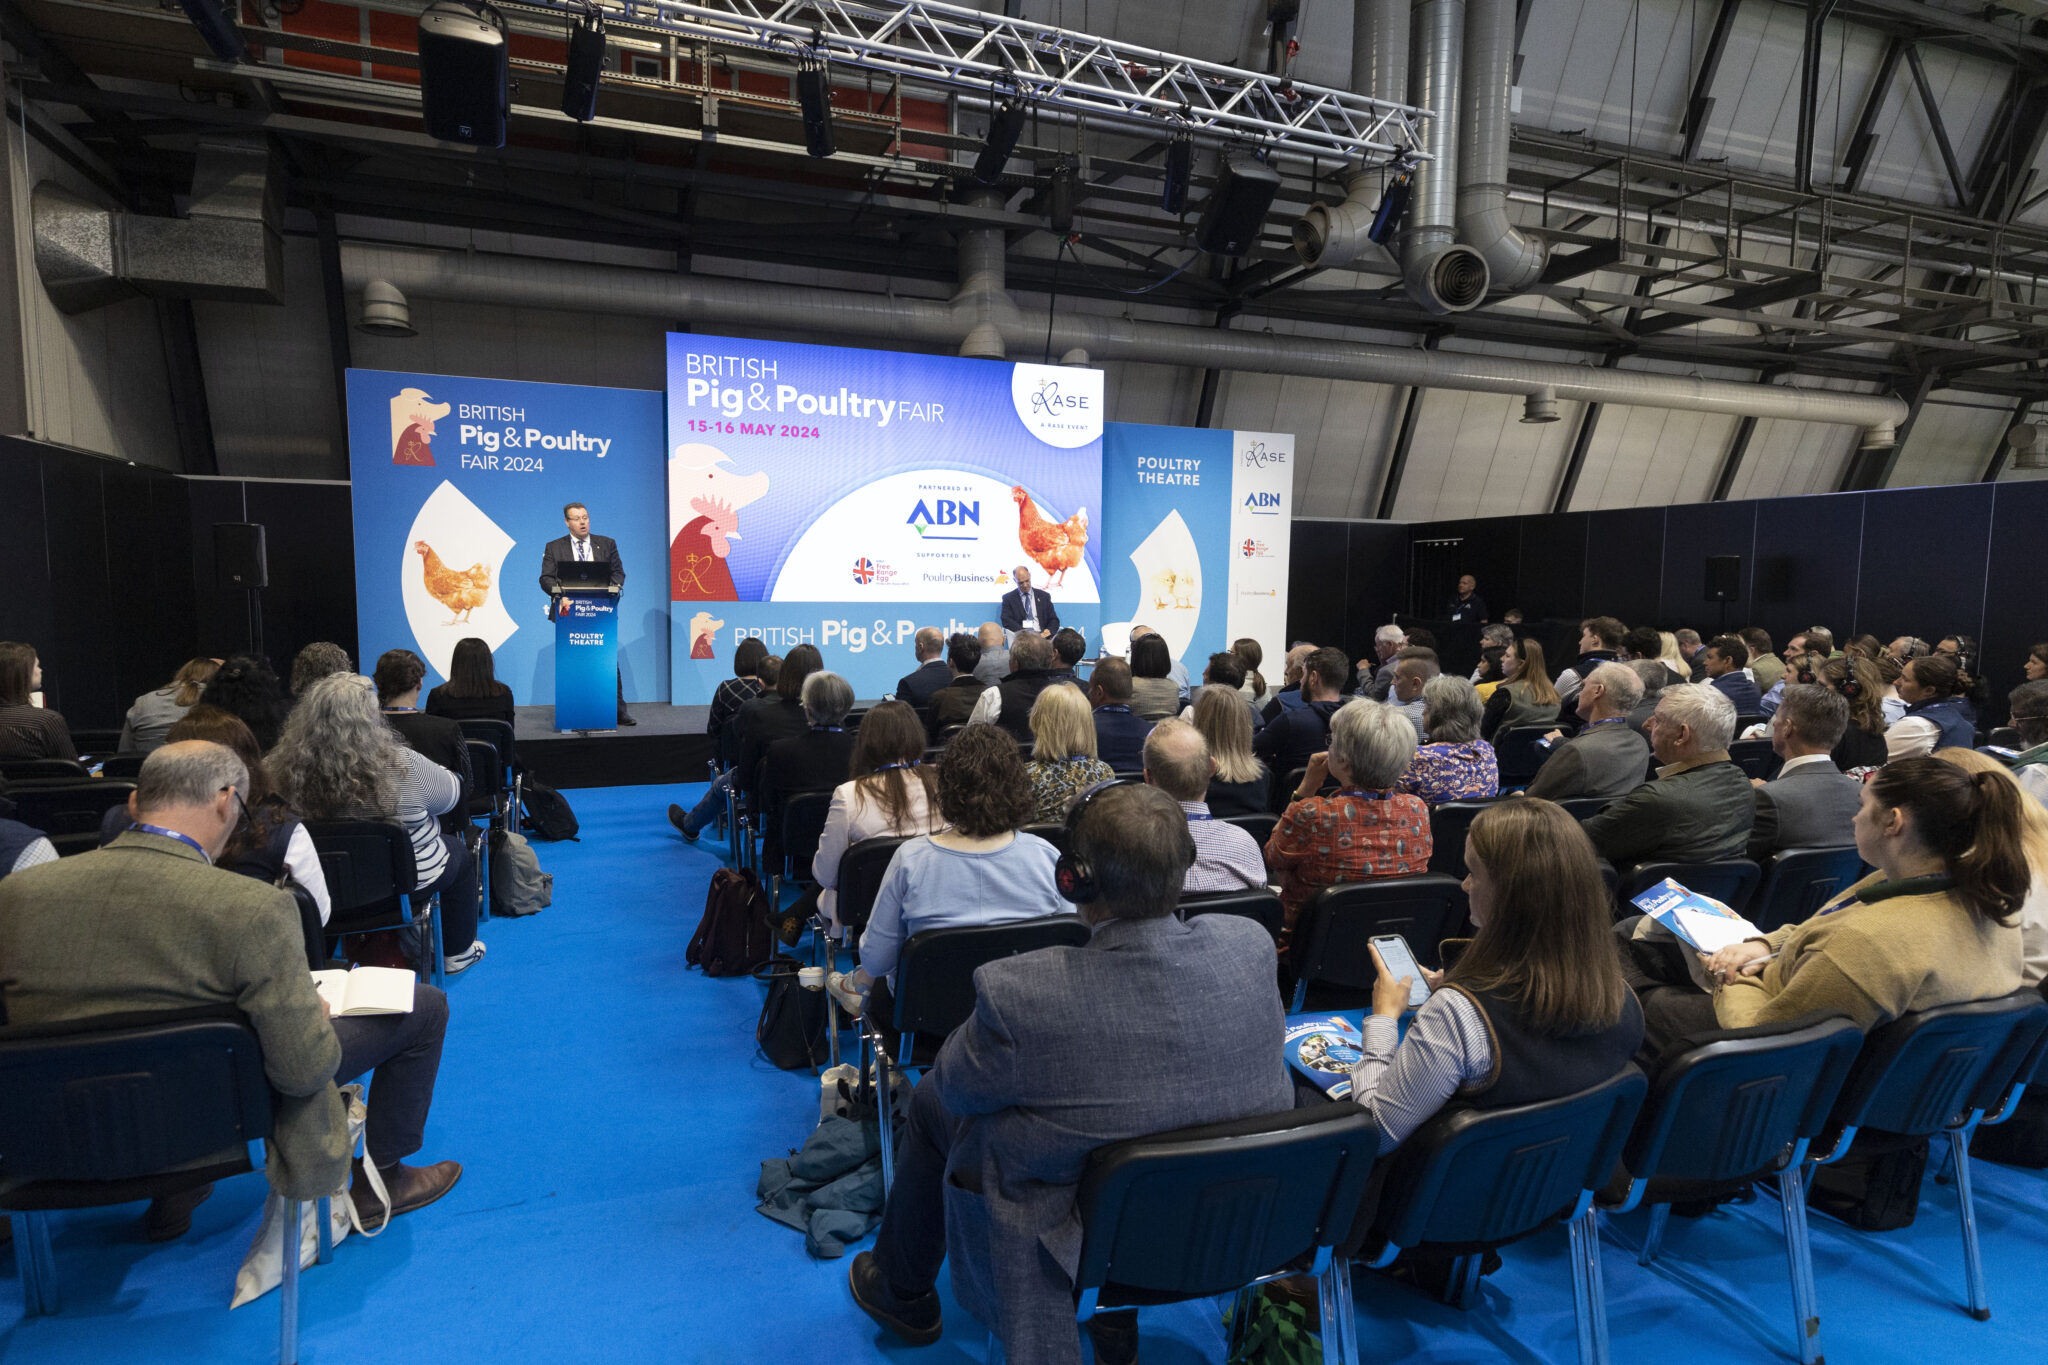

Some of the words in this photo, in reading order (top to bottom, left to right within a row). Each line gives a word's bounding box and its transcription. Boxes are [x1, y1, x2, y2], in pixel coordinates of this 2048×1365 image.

[686, 353, 778, 381] BRITISH
[687, 378, 744, 418] Pig
[747, 382, 772, 412] &
[776, 384, 897, 428] Poultry
[899, 401, 945, 423] FAIR
[1031, 381, 1090, 417] RASE
[458, 404, 526, 423] BRITISH
[687, 419, 735, 435] 15-16
[740, 422, 776, 436] MAY
[780, 425, 820, 439] 2024
[460, 424, 500, 452] Pig
[503, 426, 522, 448] &
[525, 428, 612, 458] Poultry
[460, 454, 500, 471] FAIR
[503, 456, 545, 473] 2024
[1137, 456, 1201, 471] POULTRY
[1246, 442, 1287, 469] RASE
[918, 484, 961, 492] PARTNERED
[1137, 471, 1201, 486] THEATRE
[1244, 492, 1281, 507] ABN
[906, 498, 980, 527] ABN
[876, 568, 898, 577] Range
[876, 574, 889, 582] Egg
[923, 572, 995, 584] PoultryBusiness
[591, 605, 613, 613] Poultry
[734, 626, 815, 647] BRITISH
[821, 619, 868, 653] Pig
[871, 619, 893, 645] &
